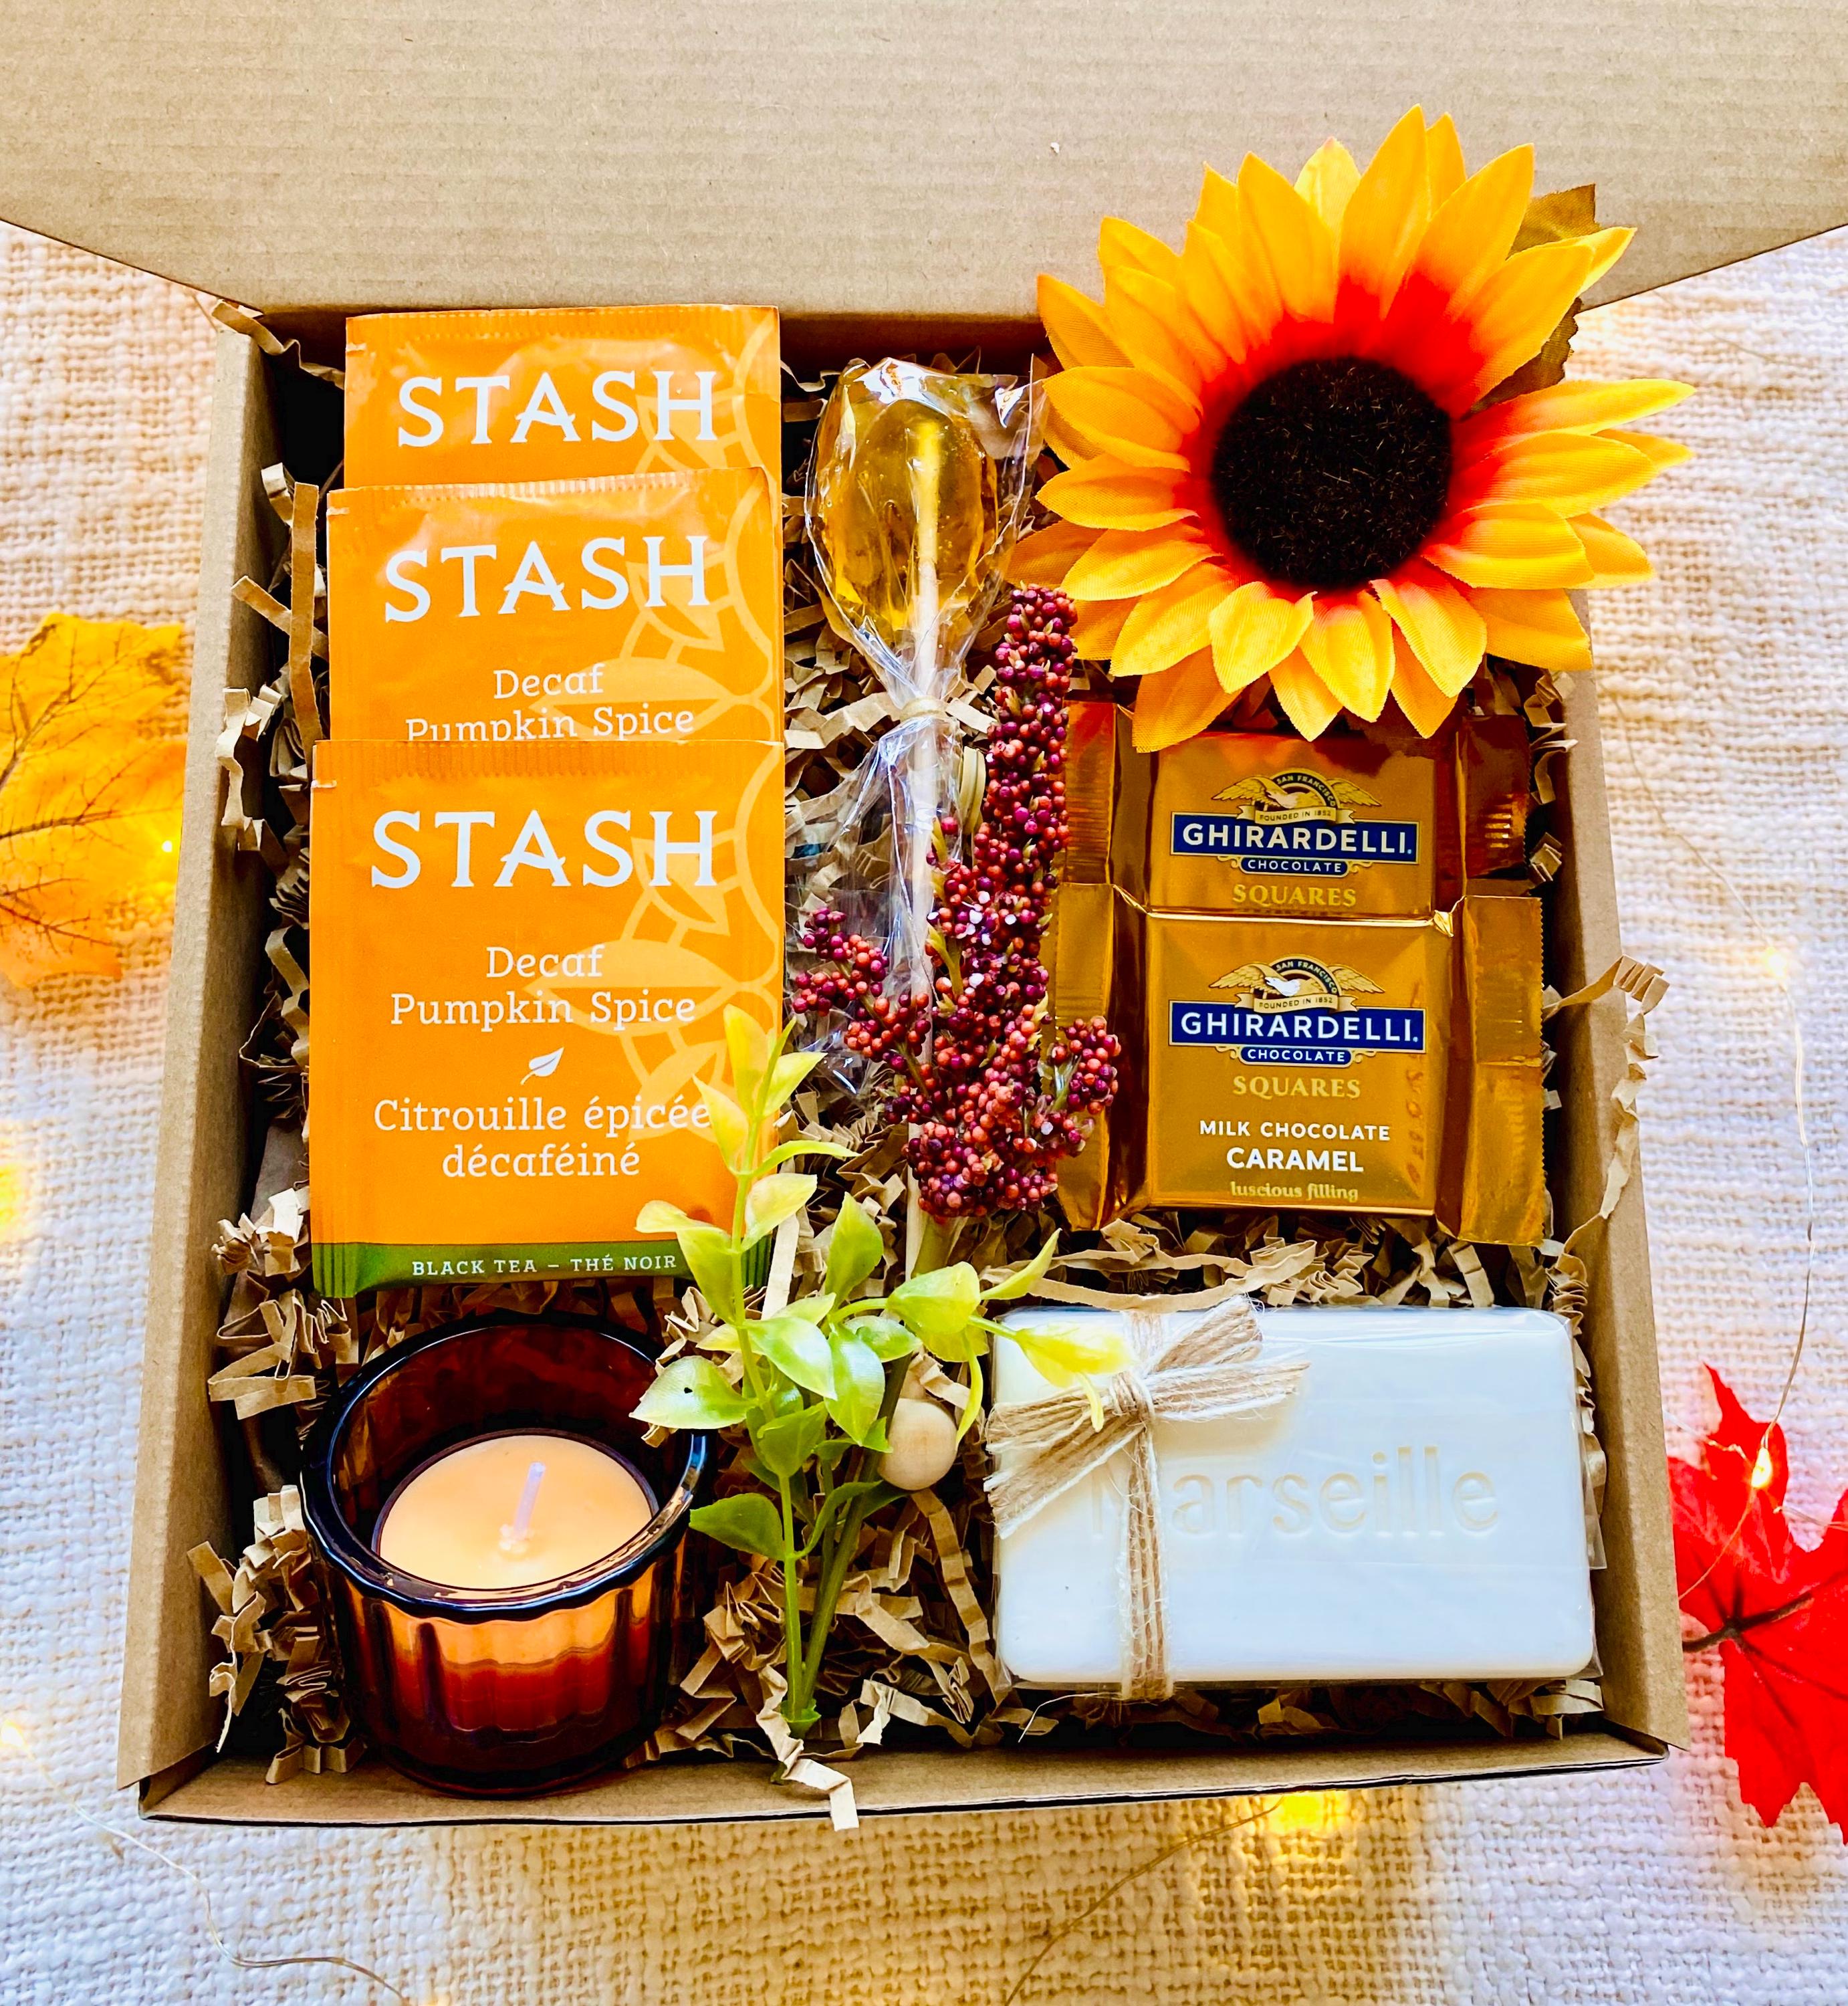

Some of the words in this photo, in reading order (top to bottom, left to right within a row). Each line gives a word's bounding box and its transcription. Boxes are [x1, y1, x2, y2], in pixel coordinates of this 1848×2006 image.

[398, 370, 717, 447] STASH
[385, 535, 710, 623] STASH
[493, 663, 604, 700] Decaf
[593, 702, 695, 742] Spice
[1276, 775, 1294, 784] SAN
[1297, 775, 1337, 807] FRANCISCO
[1260, 812, 1299, 822] FOUNDED
[371, 809, 719, 889] STASH
[1248, 859, 1342, 873] CHOCOLATE
[1233, 883, 1357, 908] SQUARES
[486, 945, 604, 979] Decaf
[1276, 961, 1294, 971] SAN
[1297, 960, 1337, 994] FRANCISCO
[391, 991, 573, 1032] Pumpkin
[590, 990, 695, 1032] Spice
[1259, 1000, 1300, 1009] FOUNDED
[1248, 1048, 1345, 1063] CHOCOLATE
[1233, 1075, 1361, 1101] SQUARES
[374, 1097, 567, 1132] Citrouille
[584, 1094, 710, 1140] épicée
[1199, 1120, 1250, 1137] MILK
[1260, 1121, 1391, 1141] CHOCOLATE
[442, 1141, 641, 1178] décaféiné
[1226, 1147, 1364, 1173] CARAMEL
[1230, 1181, 1302, 1198] luscious
[1307, 1182, 1359, 1202] filling
[412, 1260, 485, 1276] BLACK
[496, 1260, 537, 1274] TEA
[570, 1253, 614, 1272] THÉ
[624, 1254, 677, 1270] NOIR
